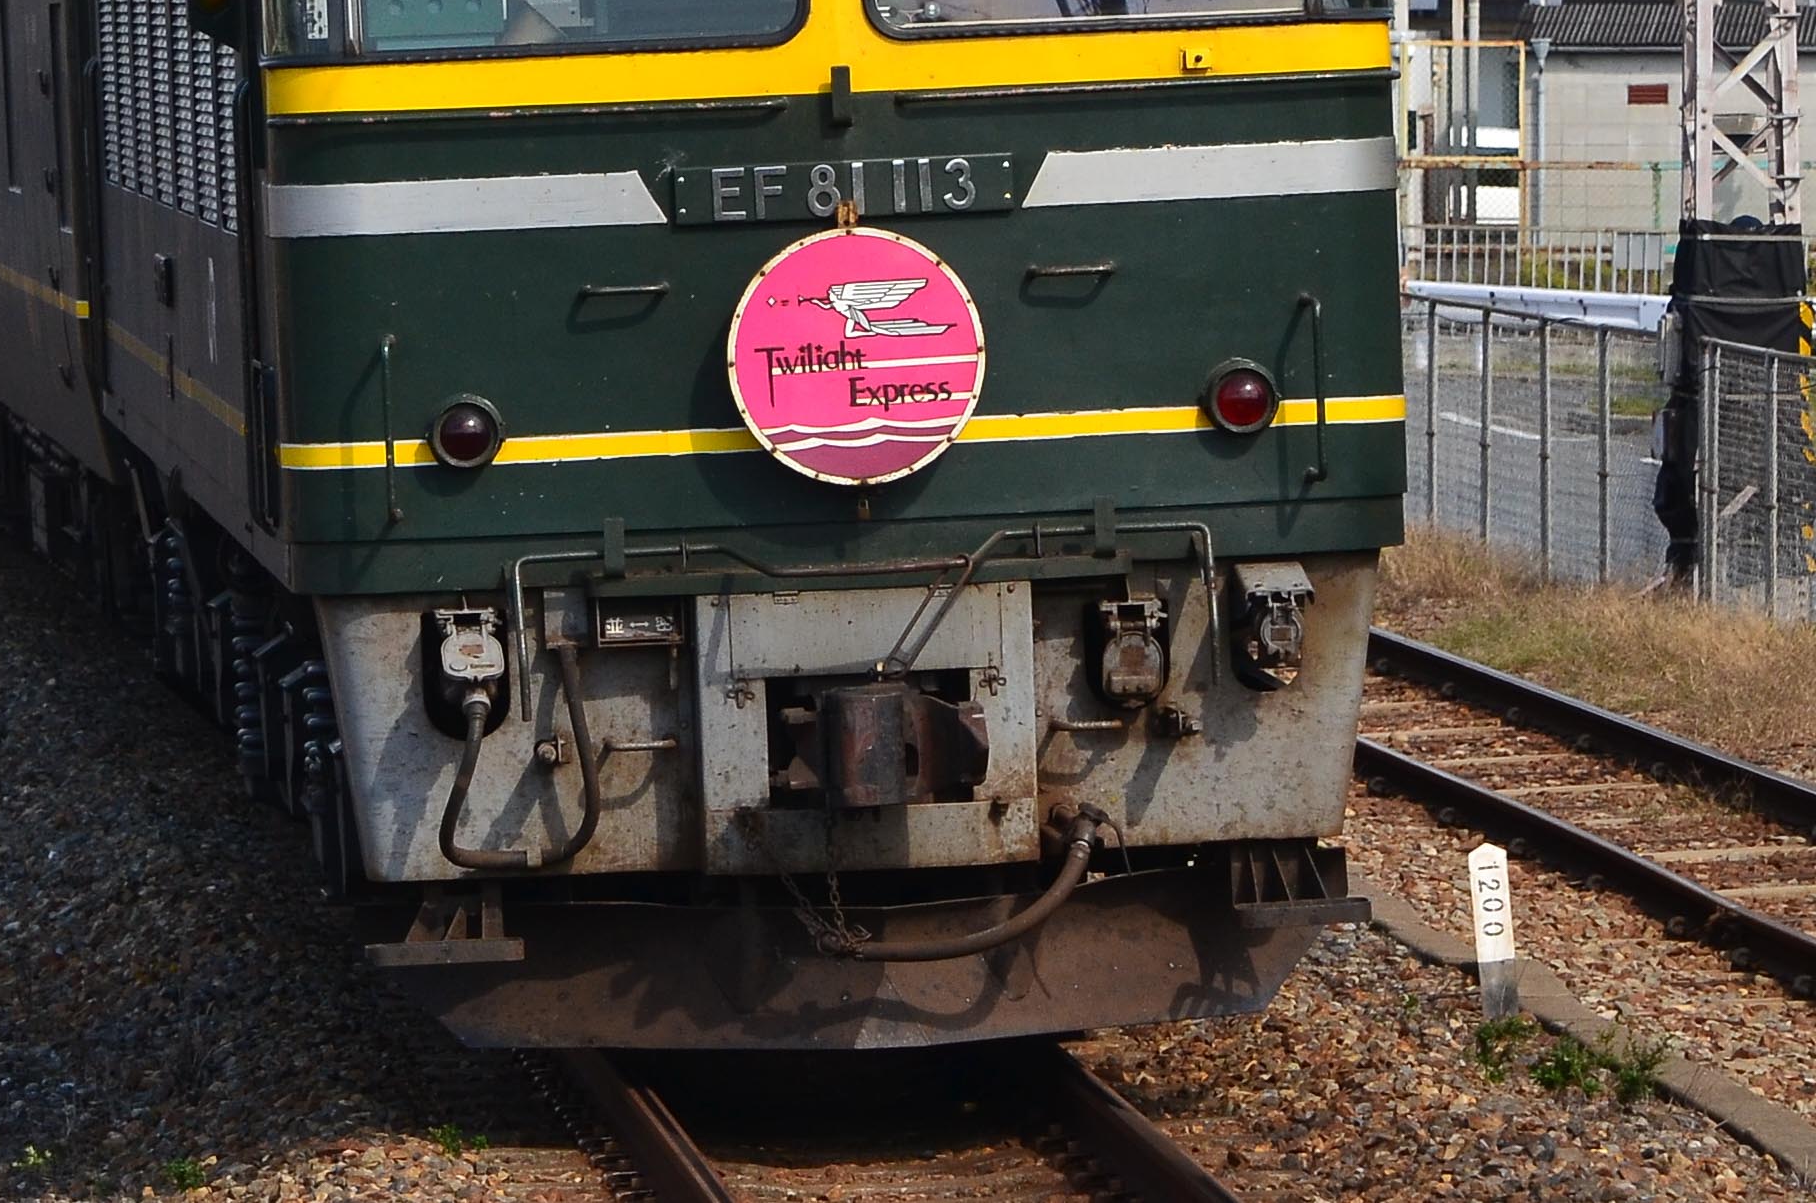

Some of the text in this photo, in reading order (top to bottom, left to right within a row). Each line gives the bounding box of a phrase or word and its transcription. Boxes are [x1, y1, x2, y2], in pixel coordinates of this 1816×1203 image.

[711, 158, 977, 222] EF 81 113
[754, 341, 869, 408] Twilight
[849, 376, 953, 412] Express
[1478, 861, 1505, 937] 1200
